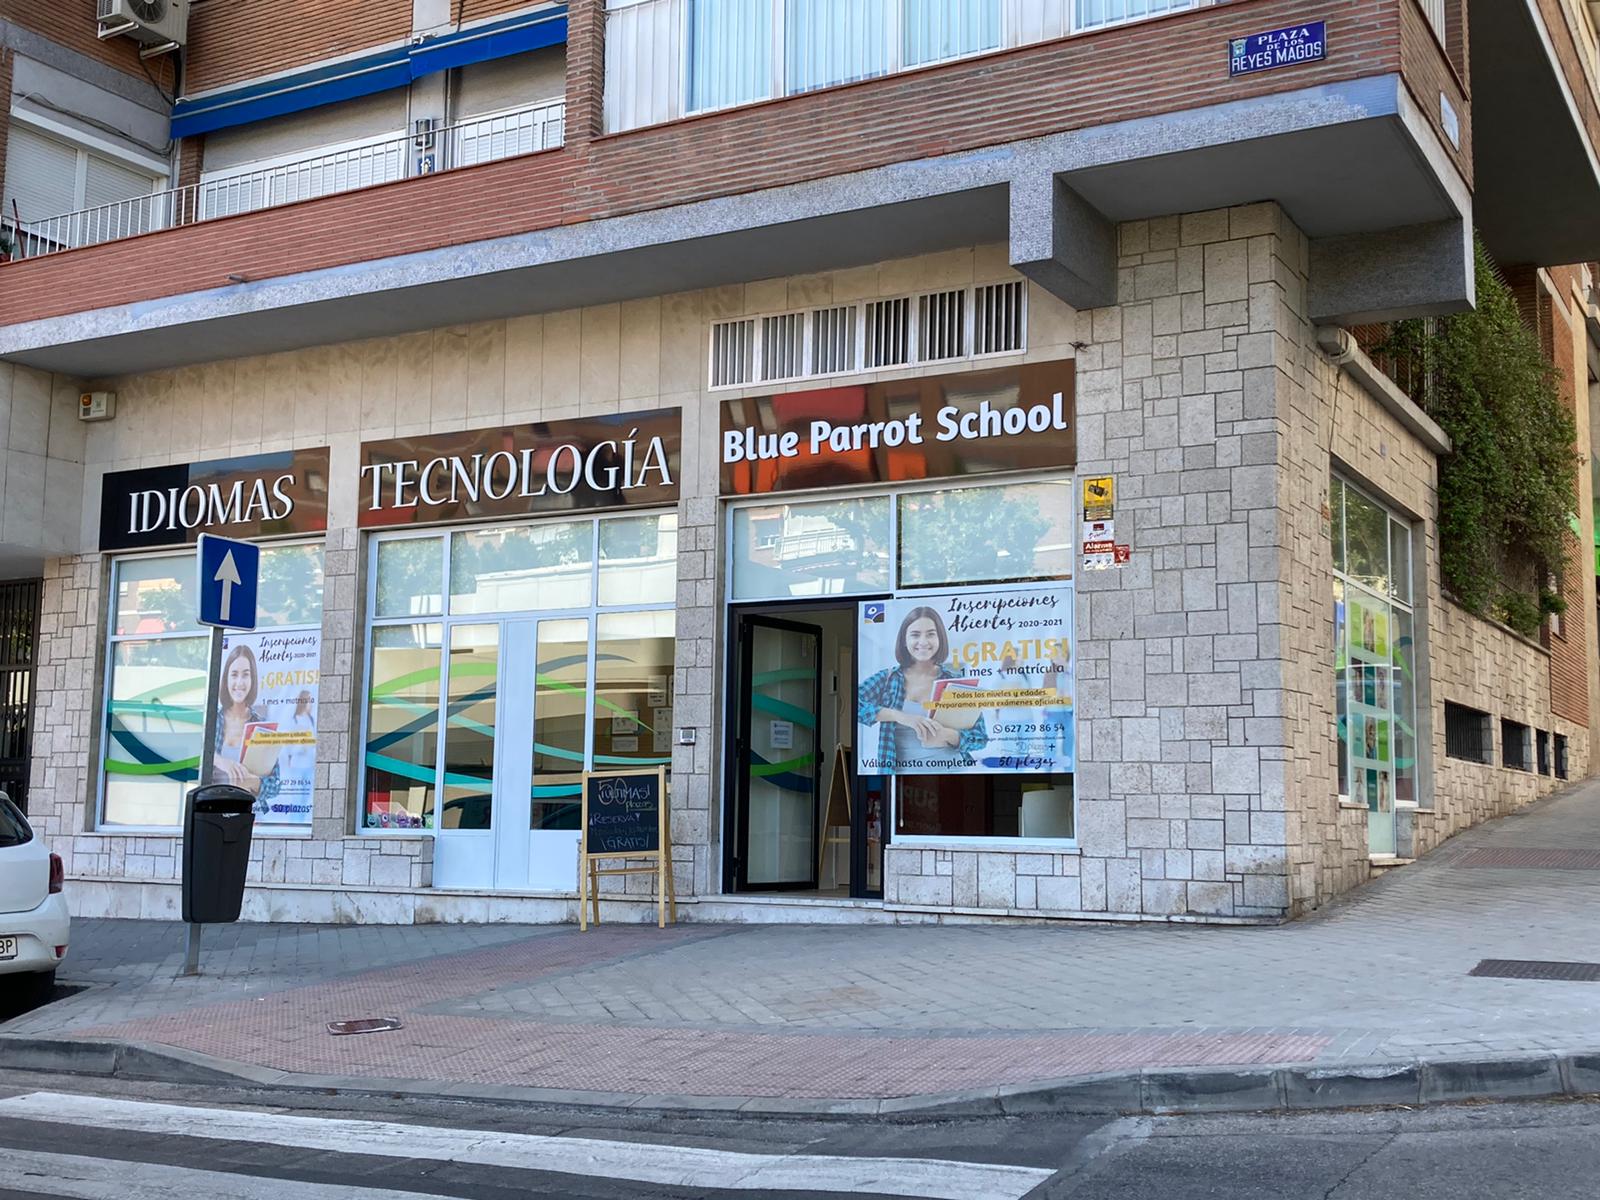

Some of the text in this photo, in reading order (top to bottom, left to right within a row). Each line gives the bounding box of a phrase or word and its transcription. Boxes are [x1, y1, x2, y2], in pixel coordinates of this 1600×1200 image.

[1258, 28, 1309, 45] PLAZA
[1266, 38, 1304, 51] DE LOS
[1231, 41, 1322, 72] REYES MAGOS
[723, 392, 1067, 463] Blue Parrot School
[361, 427, 674, 511] TECNOLOGÍA
[127, 474, 296, 534] IDIOMAS
[948, 595, 1059, 614] Inscripciones
[948, 614, 1063, 632] Abiertas 2020-2021
[960, 668, 966, 677] 1
[969, 668, 992, 677] mes
[1006, 663, 1065, 675] matrícula
[952, 691, 973, 699] Todos
[986, 690, 1011, 698] niveles
[1004, 722, 1065, 733] 627 29 86 54
[861, 754, 1057, 770] Válido hasta completar 50 plazas
